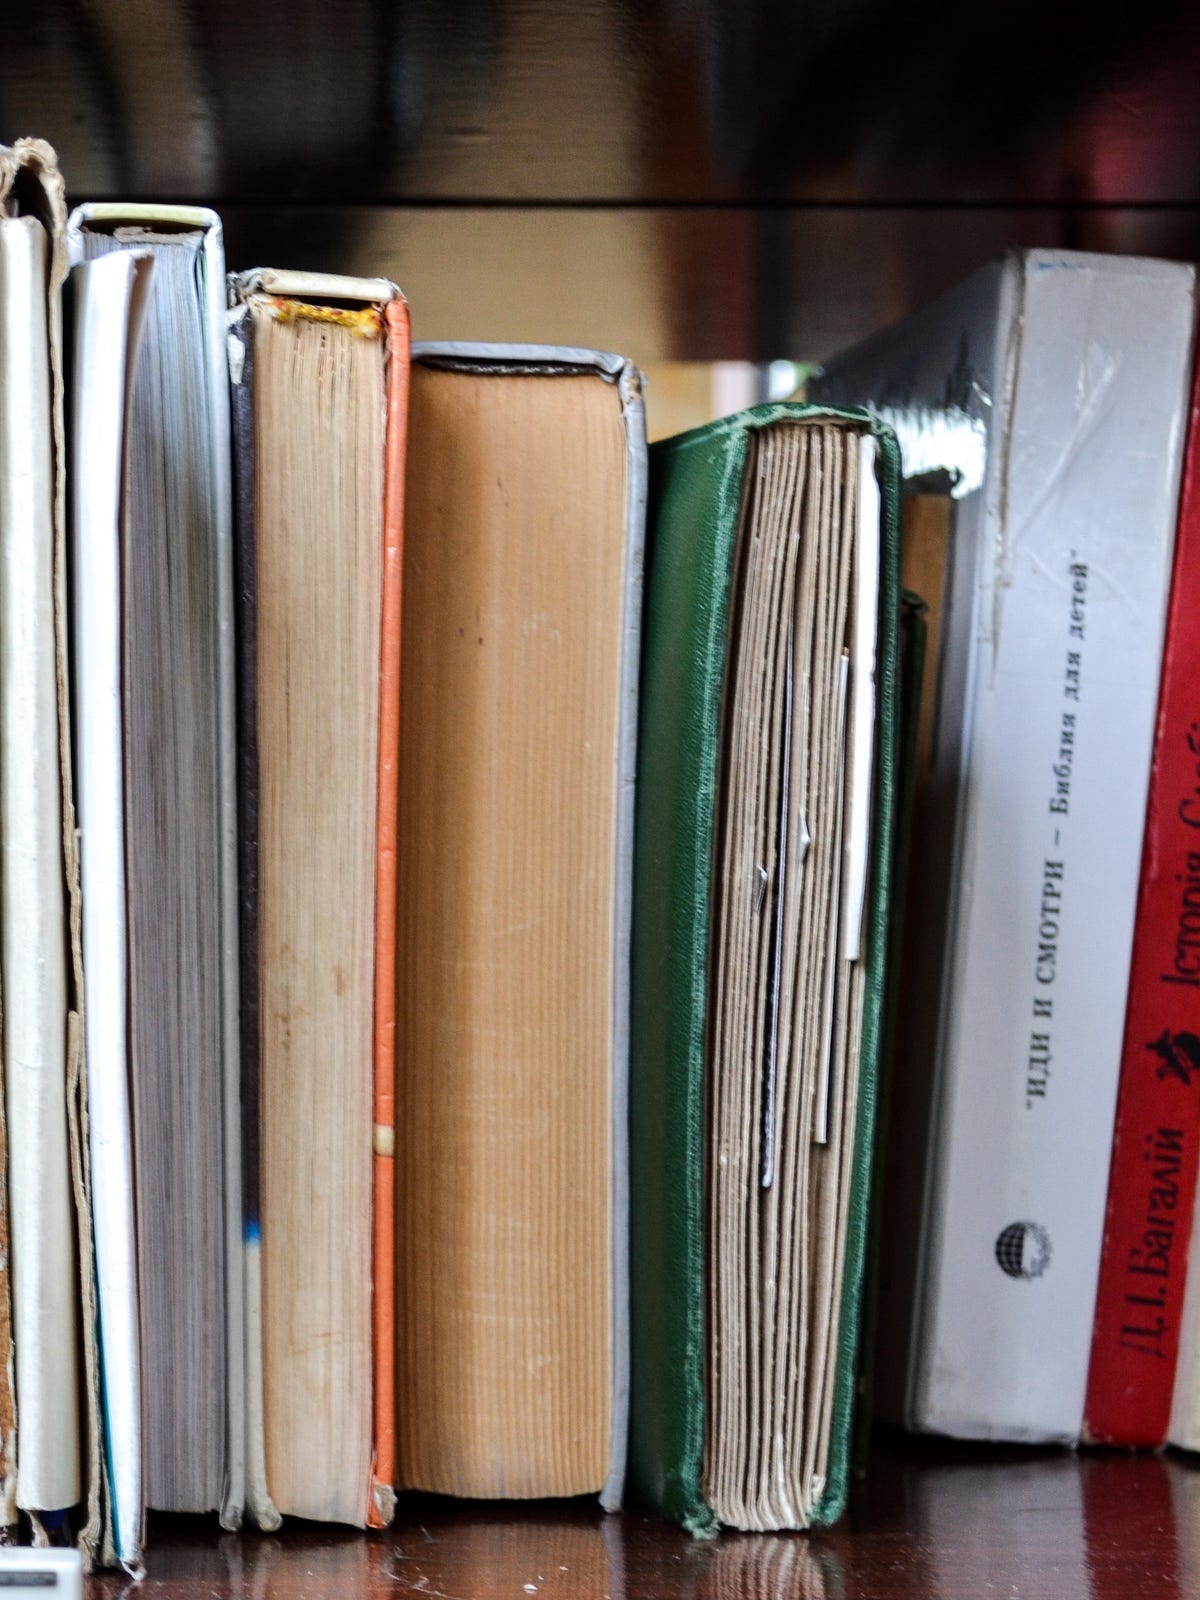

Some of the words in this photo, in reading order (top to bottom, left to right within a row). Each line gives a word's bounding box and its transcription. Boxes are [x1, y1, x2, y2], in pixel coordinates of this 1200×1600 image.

[1063, 651, 1081, 702] для
[1049, 712, 1077, 815] Библия
[1035, 859, 1064, 985] СМОТРИ
[1033, 997, 1053, 1019] И
